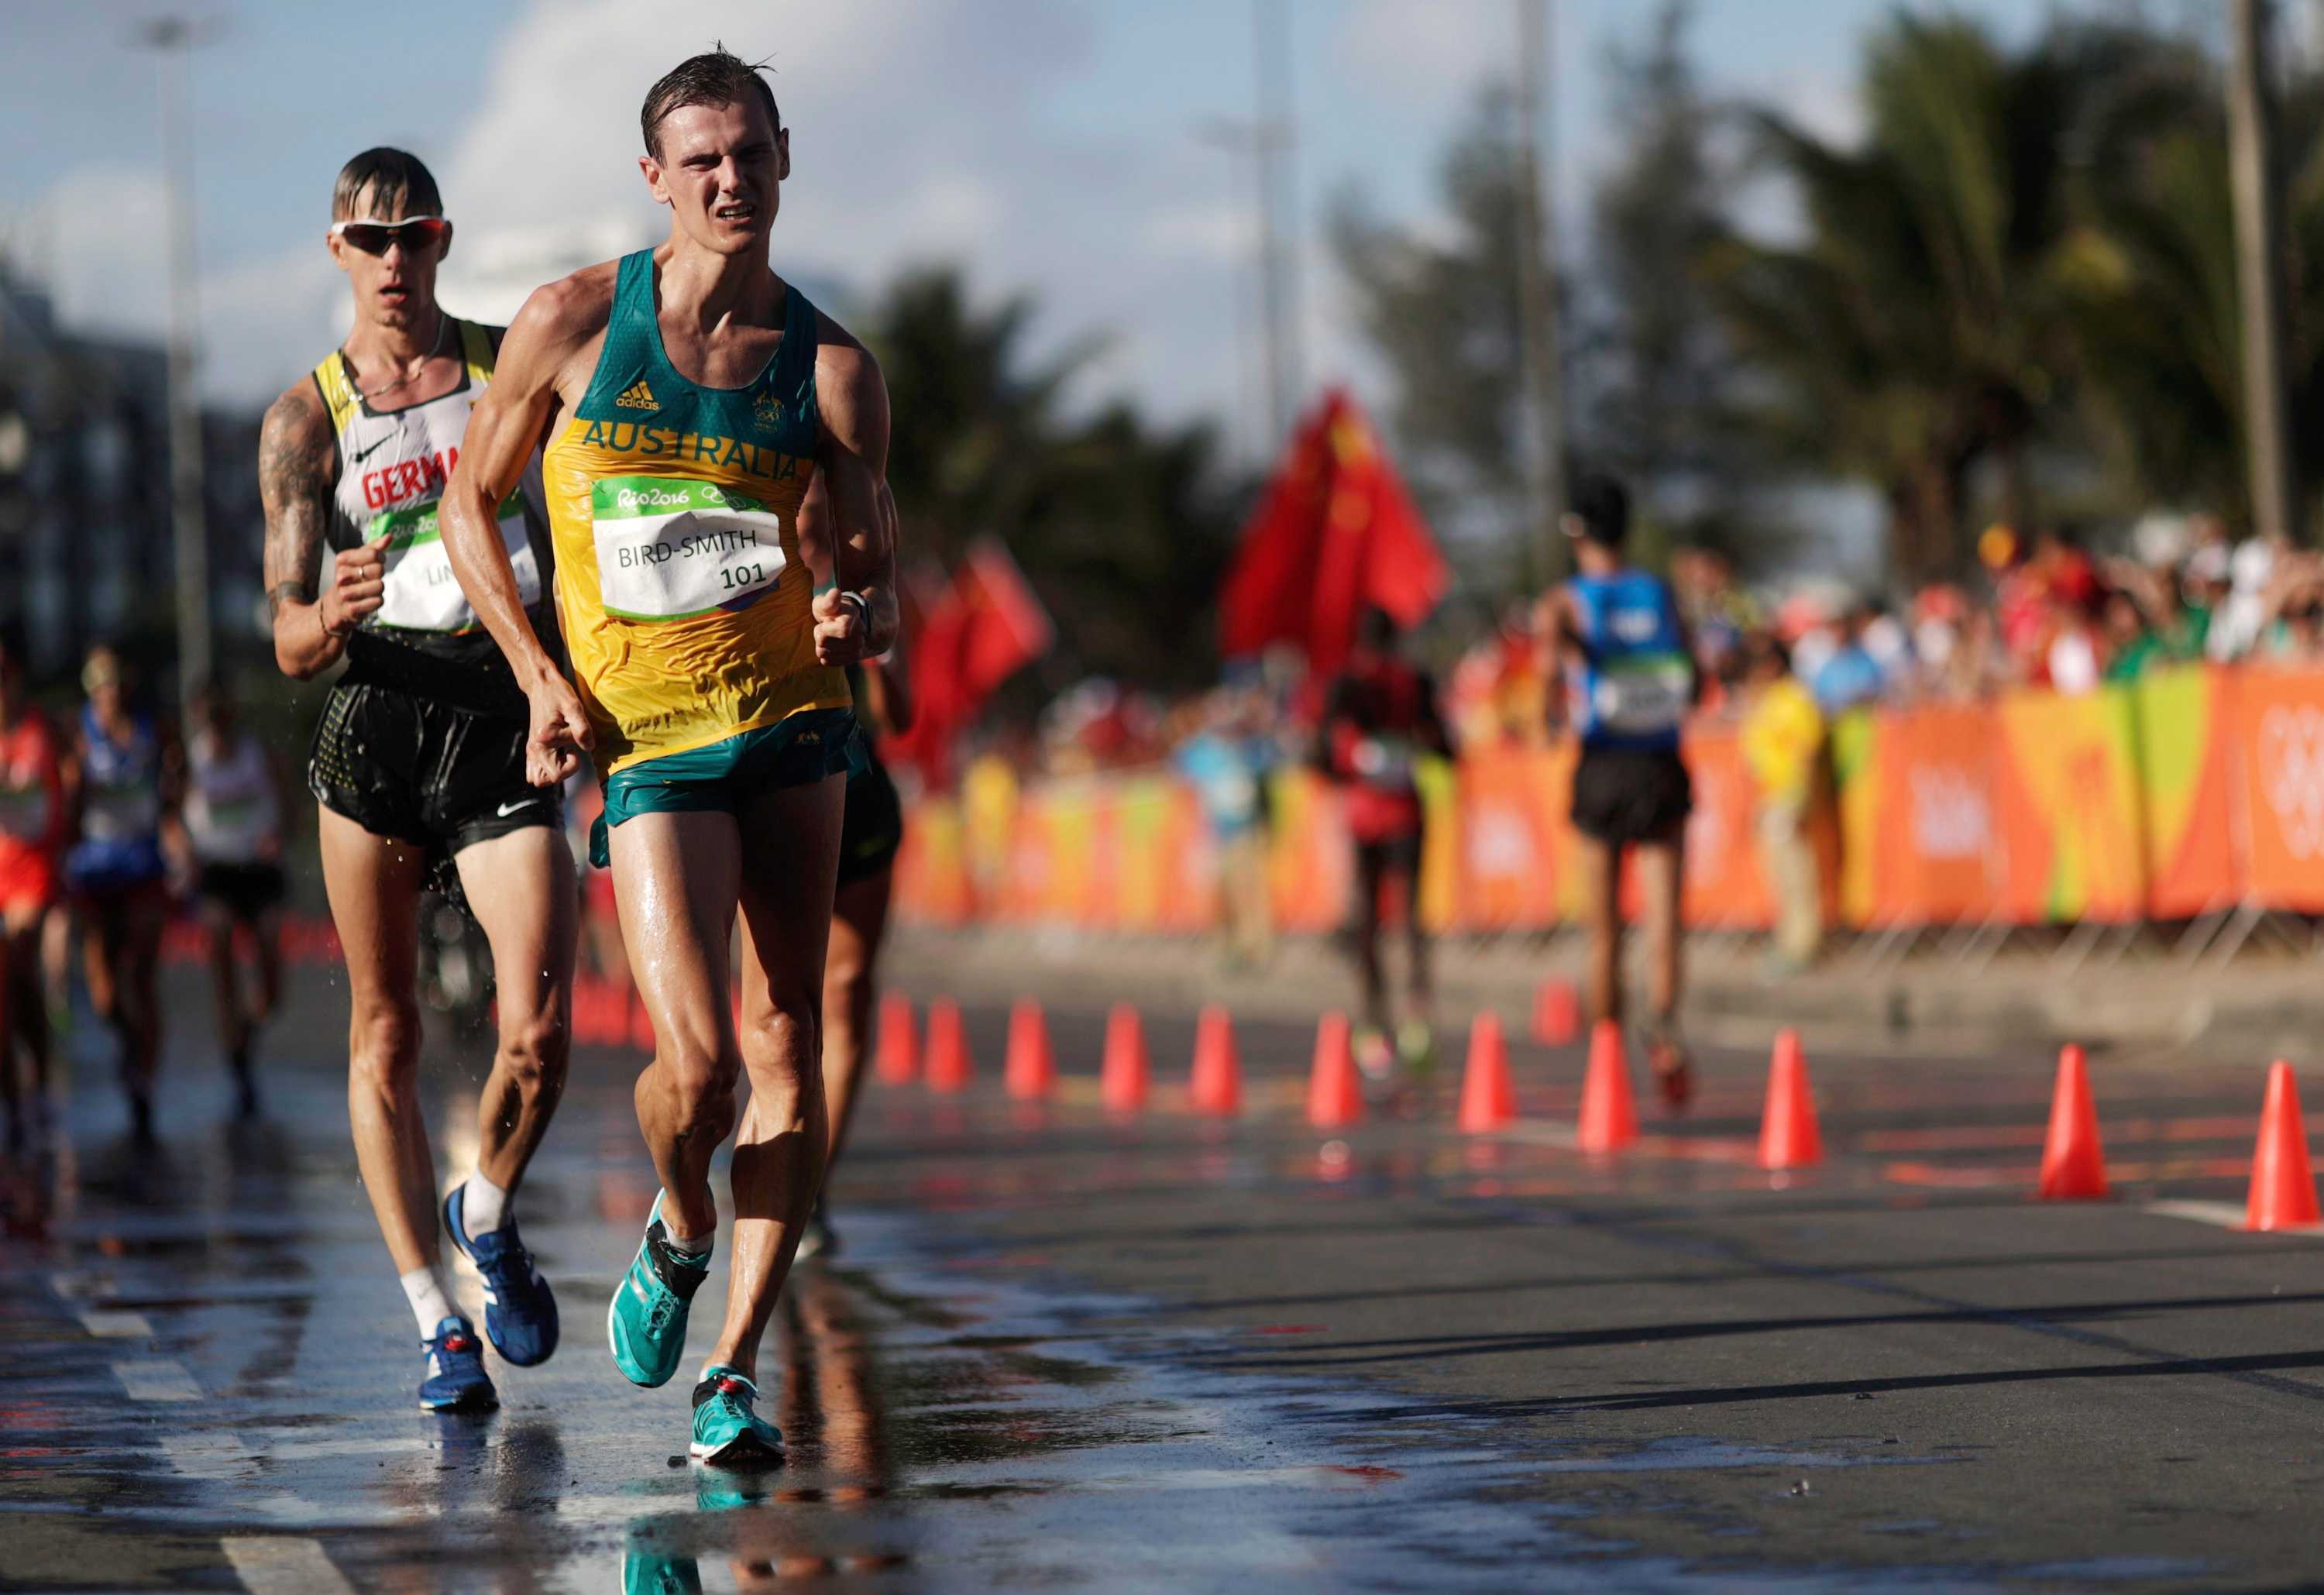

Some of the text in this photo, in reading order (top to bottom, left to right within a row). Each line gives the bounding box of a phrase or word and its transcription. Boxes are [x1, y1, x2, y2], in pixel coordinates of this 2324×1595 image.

[616, 396, 660, 411] adidas
[582, 420, 796, 480] AUSTRALIA
[617, 487, 690, 509] Rio2016
[619, 529, 757, 568] BIRD-SMITH
[720, 562, 767, 590] 101
